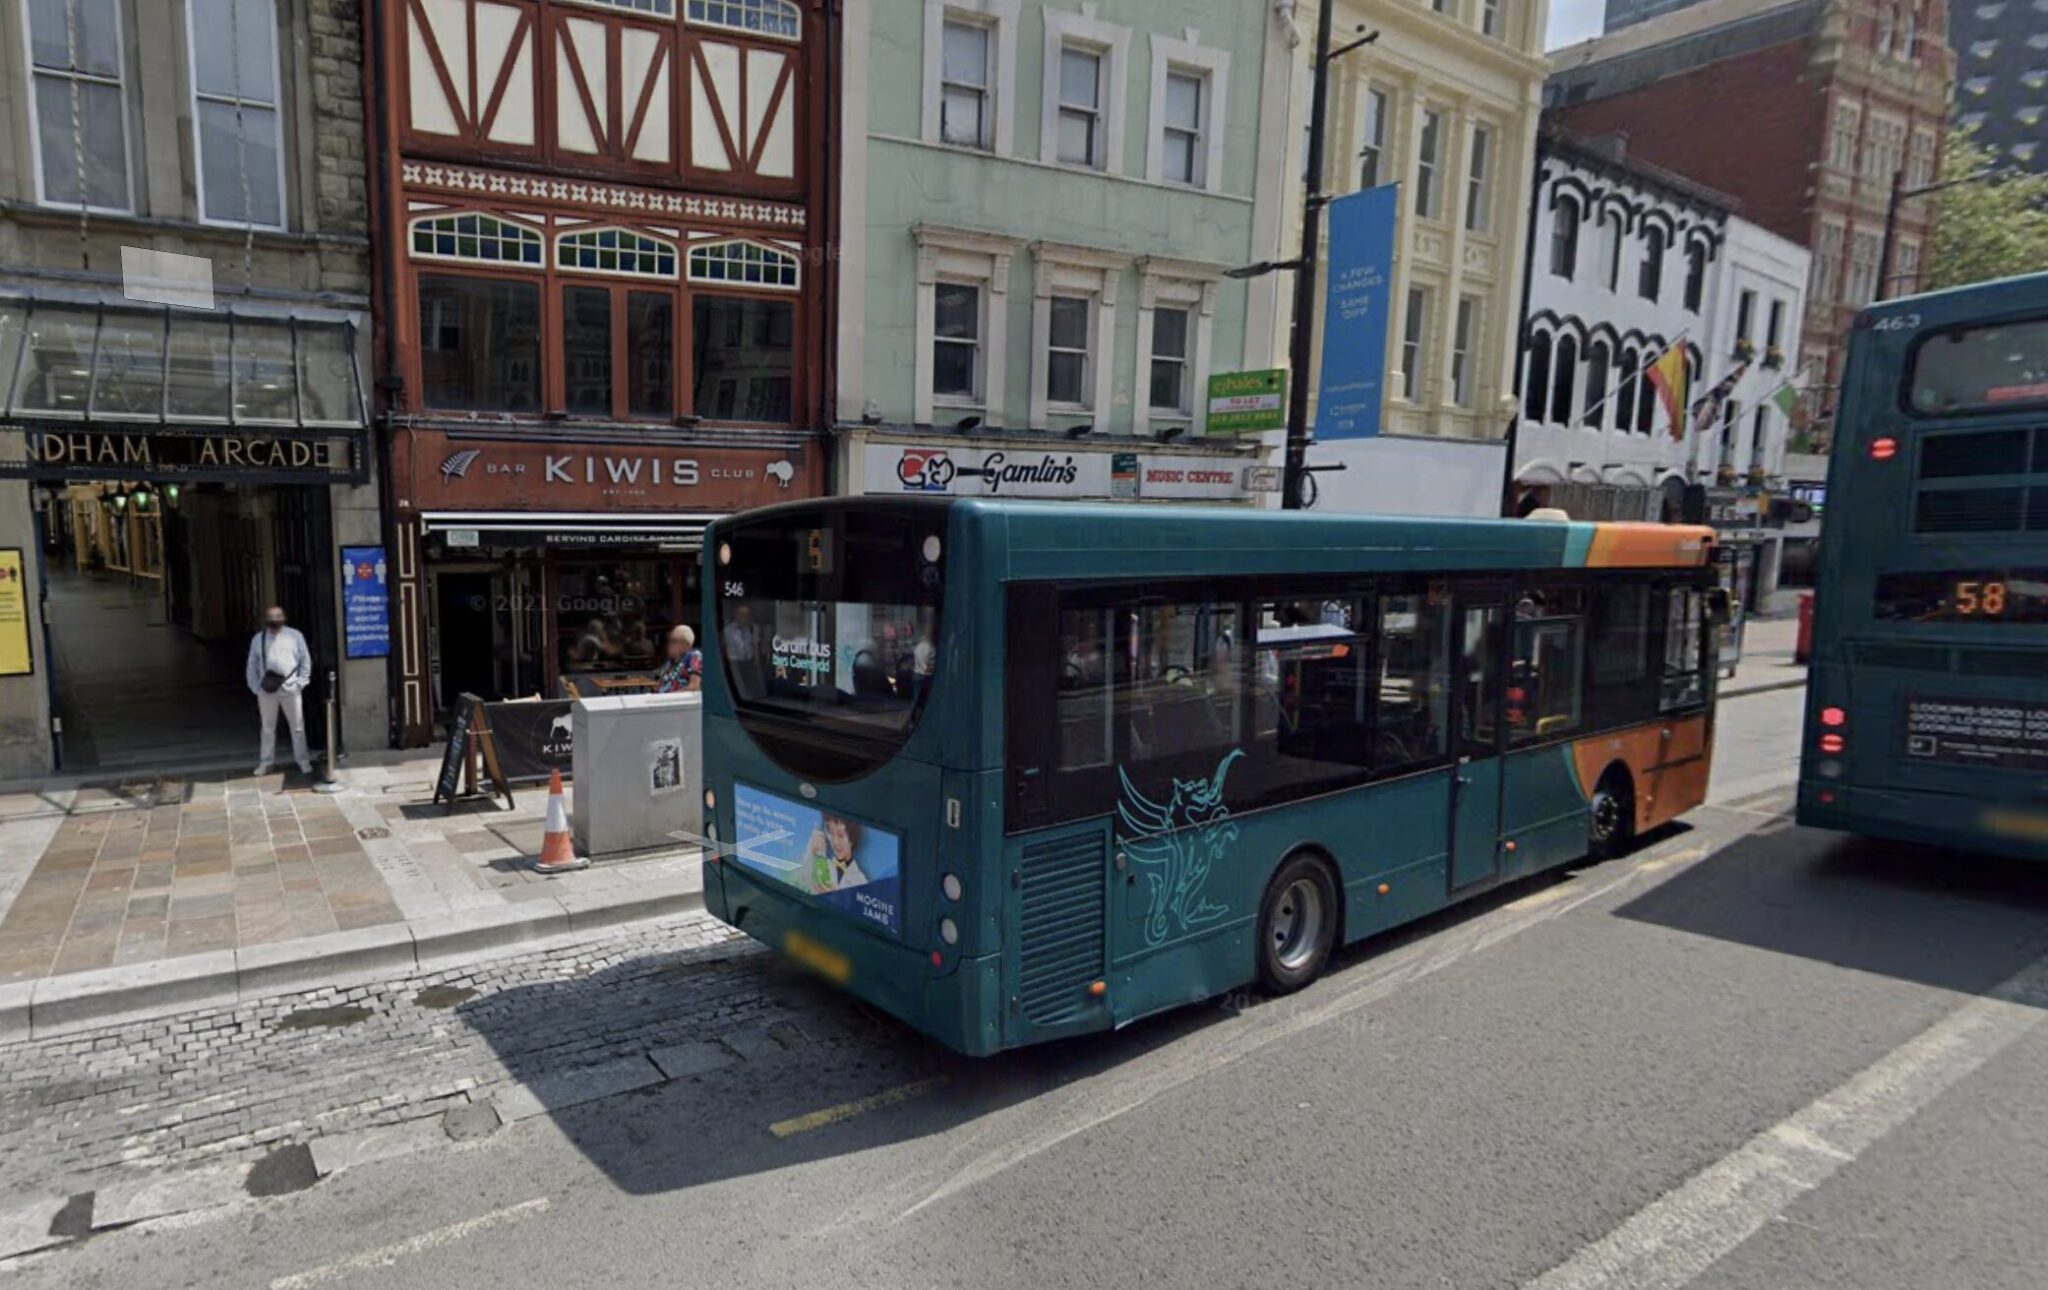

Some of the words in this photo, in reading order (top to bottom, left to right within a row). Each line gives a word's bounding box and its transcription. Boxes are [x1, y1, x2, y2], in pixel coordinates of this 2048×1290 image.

[1873, 313, 1921, 330] 463
[199, 438, 330, 467] ARCADE
[487, 463, 526, 473] BAR
[545, 455, 699, 485] KIWIS
[711, 469, 754, 479] CLUB
[983, 452, 1077, 492] Gamlin's
[1146, 469, 1183, 483] MUSIC
[1187, 471, 1234, 484] CENTRE
[546, 535, 596, 543] SERVING
[724, 582, 744, 597] 546
[1955, 582, 2005, 614] 58
[543, 743, 573, 753] KIW
